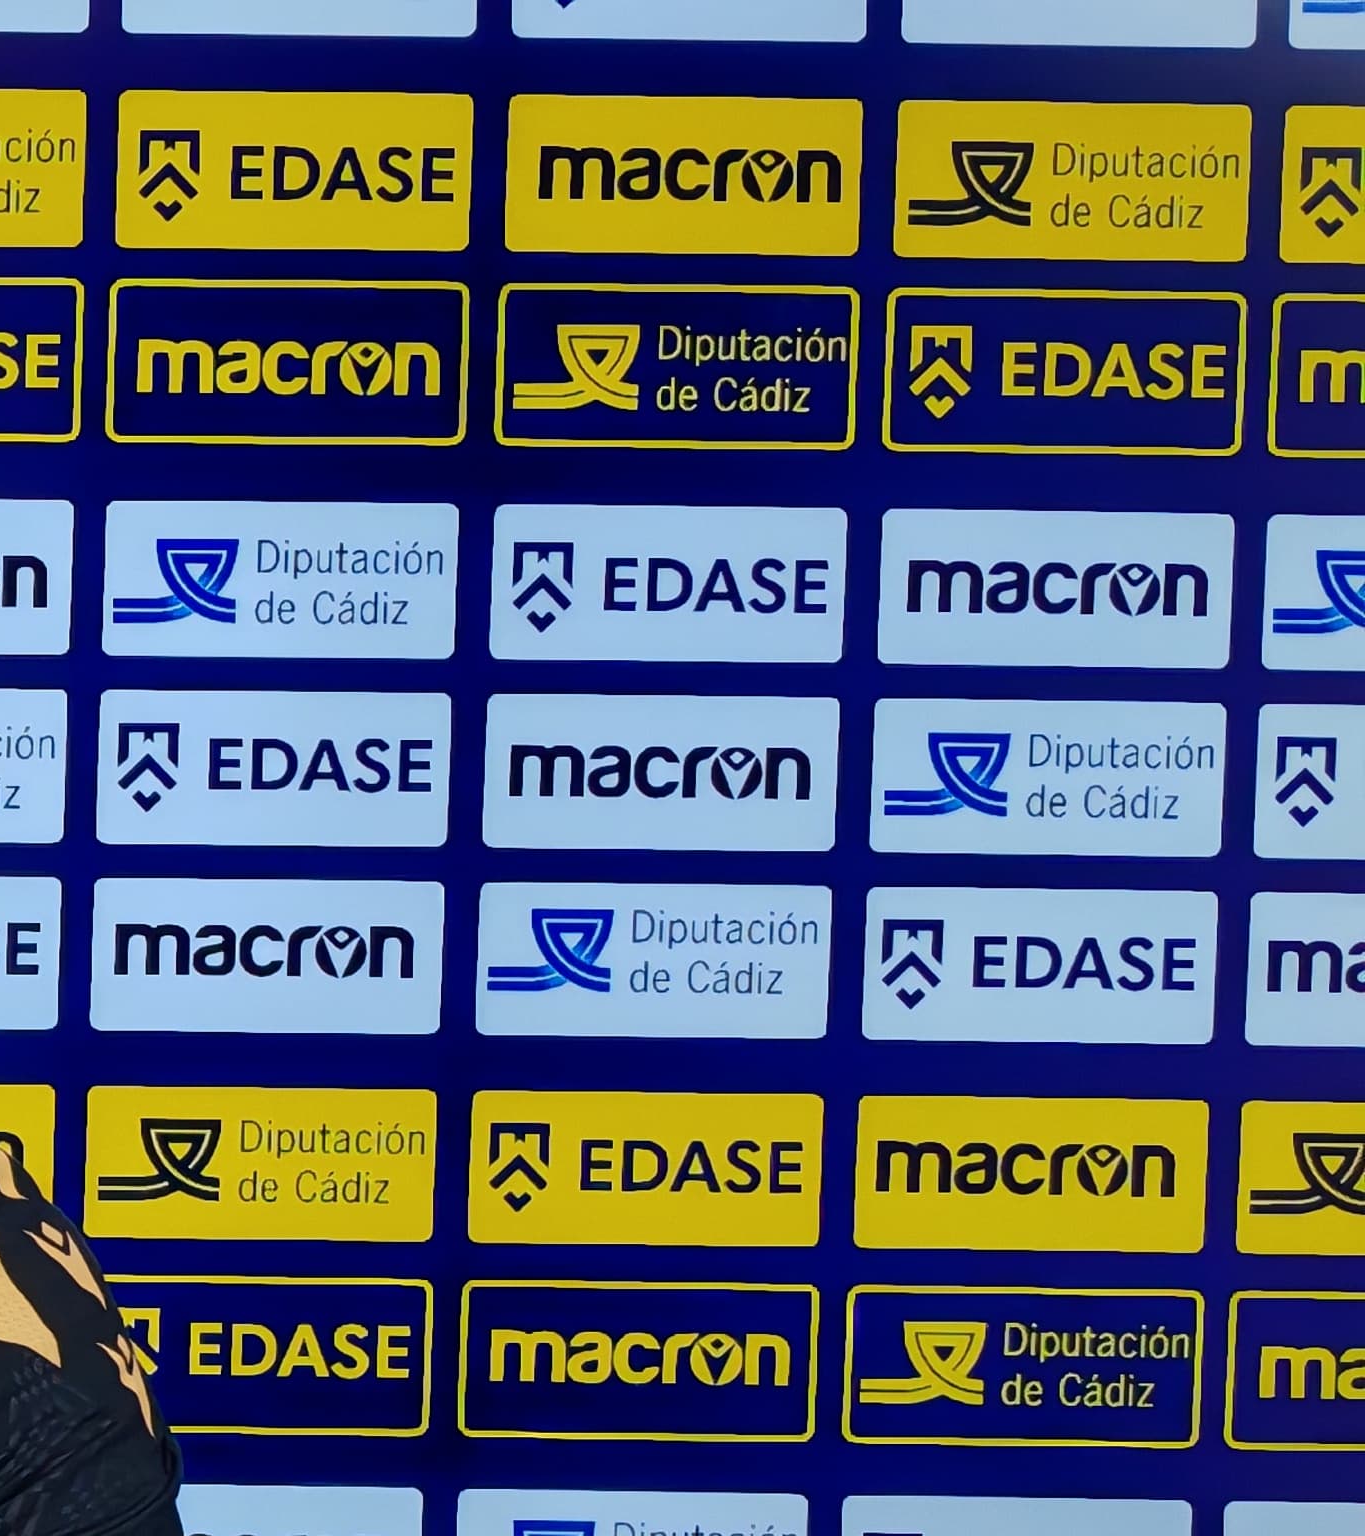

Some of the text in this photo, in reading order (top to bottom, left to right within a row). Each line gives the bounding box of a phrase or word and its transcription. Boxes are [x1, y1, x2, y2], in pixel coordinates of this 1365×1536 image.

[230, 145, 456, 203] EDASE
[538, 145, 842, 203] macron
[1052, 142, 1240, 183] Diputación
[1050, 193, 1204, 229] de Cádiz
[136, 338, 441, 396] macron
[658, 325, 847, 367] Diputación
[656, 376, 811, 413] de Cádiz
[1001, 341, 1227, 401] EDASE
[257, 539, 444, 580] Diputación
[254, 590, 409, 626] de Cádiz
[603, 557, 829, 614] EDASE
[906, 559, 1209, 617] macron
[208, 737, 433, 794] EDASE
[508, 744, 811, 801] macron
[1028, 733, 1215, 775] Diputación
[1025, 783, 1179, 820] de Cádiz
[113, 923, 415, 979] macron
[632, 909, 818, 950] Diputación
[629, 959, 783, 995] de Cádiz
[972, 935, 1197, 992] EDASE
[240, 1119, 425, 1159] Diputación
[238, 1169, 390, 1205] de Cádiz
[579, 1139, 804, 1194] EDASE
[875, 1140, 1176, 1198] macron
[188, 1322, 412, 1380] EDASE
[488, 1328, 791, 1387] macron
[1003, 1322, 1190, 1364] Diputación
[1000, 1372, 1155, 1408] de Cádiz
